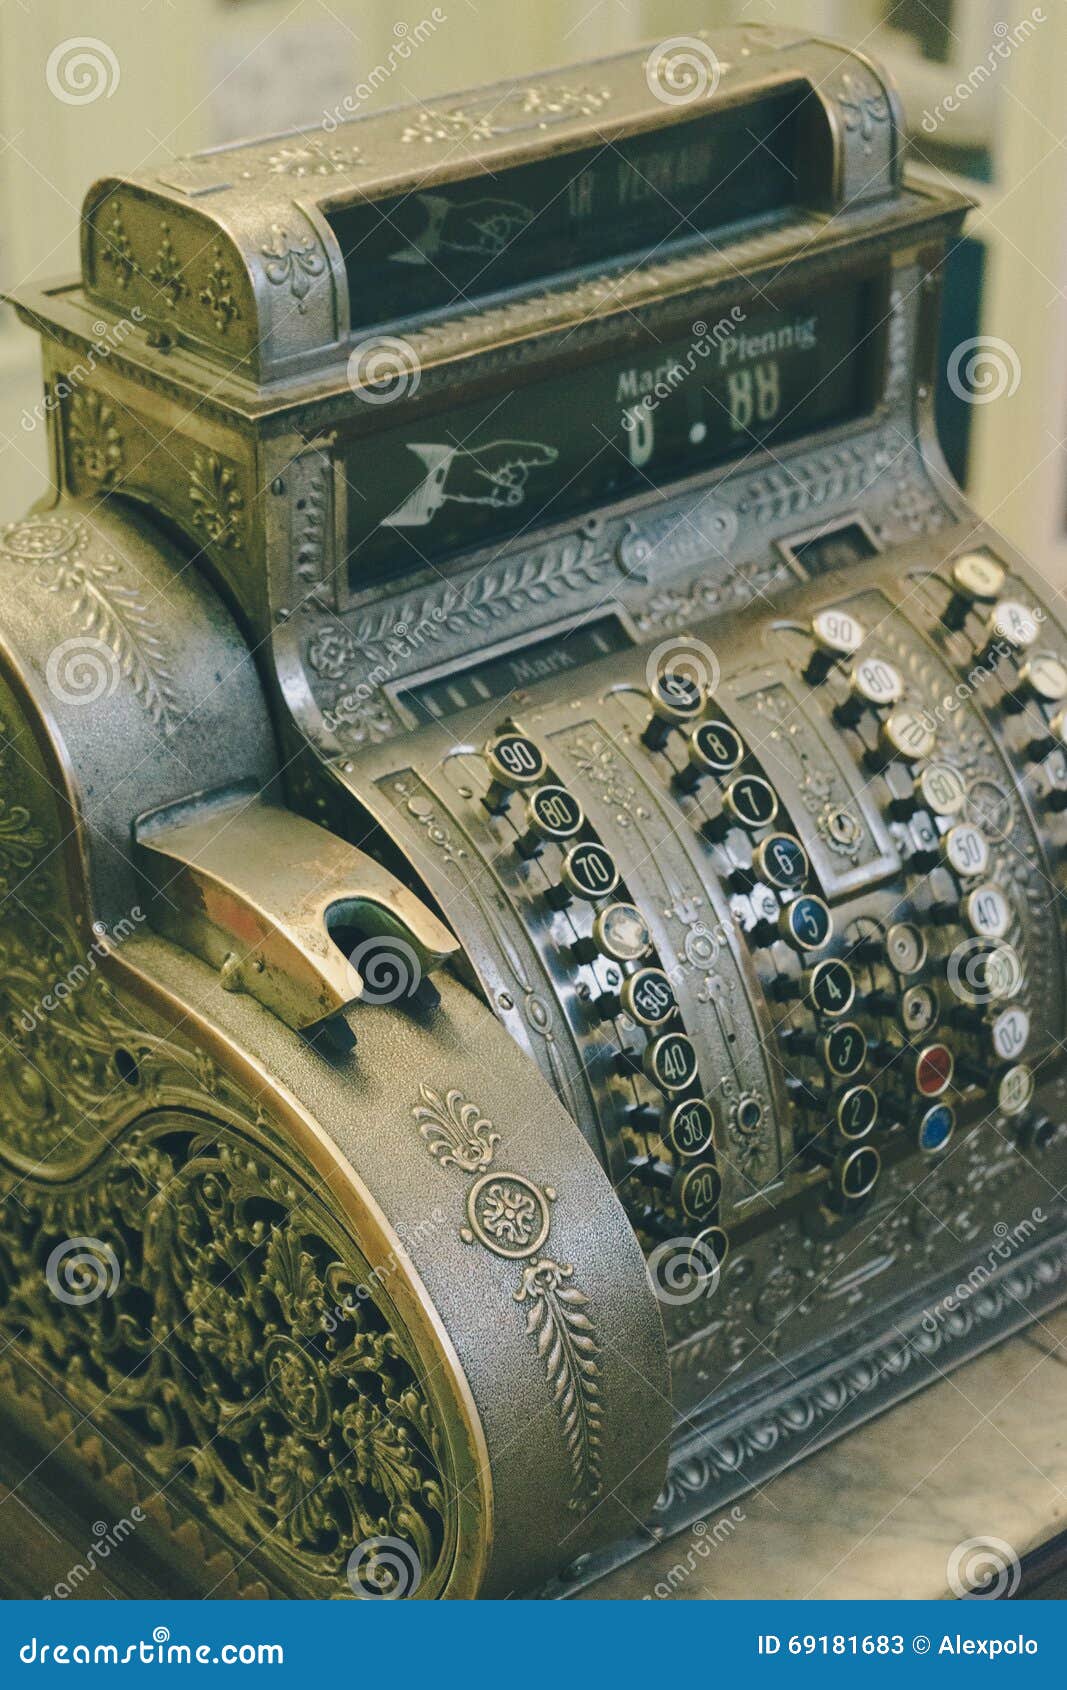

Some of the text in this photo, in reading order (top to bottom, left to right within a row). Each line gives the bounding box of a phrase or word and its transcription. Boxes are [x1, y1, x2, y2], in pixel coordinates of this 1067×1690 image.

[826, 616, 851, 643] 90
[509, 649, 576, 683] Mark
[862, 666, 894, 694] 80
[500, 742, 536, 773] 90
[706, 732, 728, 760] 8
[540, 796, 573, 828] 80
[740, 786, 760, 816] 7
[773, 845, 794, 875] 6
[955, 833, 982, 867] 50
[576, 853, 610, 887] 70
[802, 907, 818, 938] 5
[976, 896, 1001, 929] 40
[825, 973, 842, 1000] 4
[664, 1044, 687, 1080] 40
[839, 1035, 852, 1067] 3
[850, 1096, 862, 1127] 2
[680, 1111, 701, 1146] 30
[692, 1174, 713, 1208] 20
